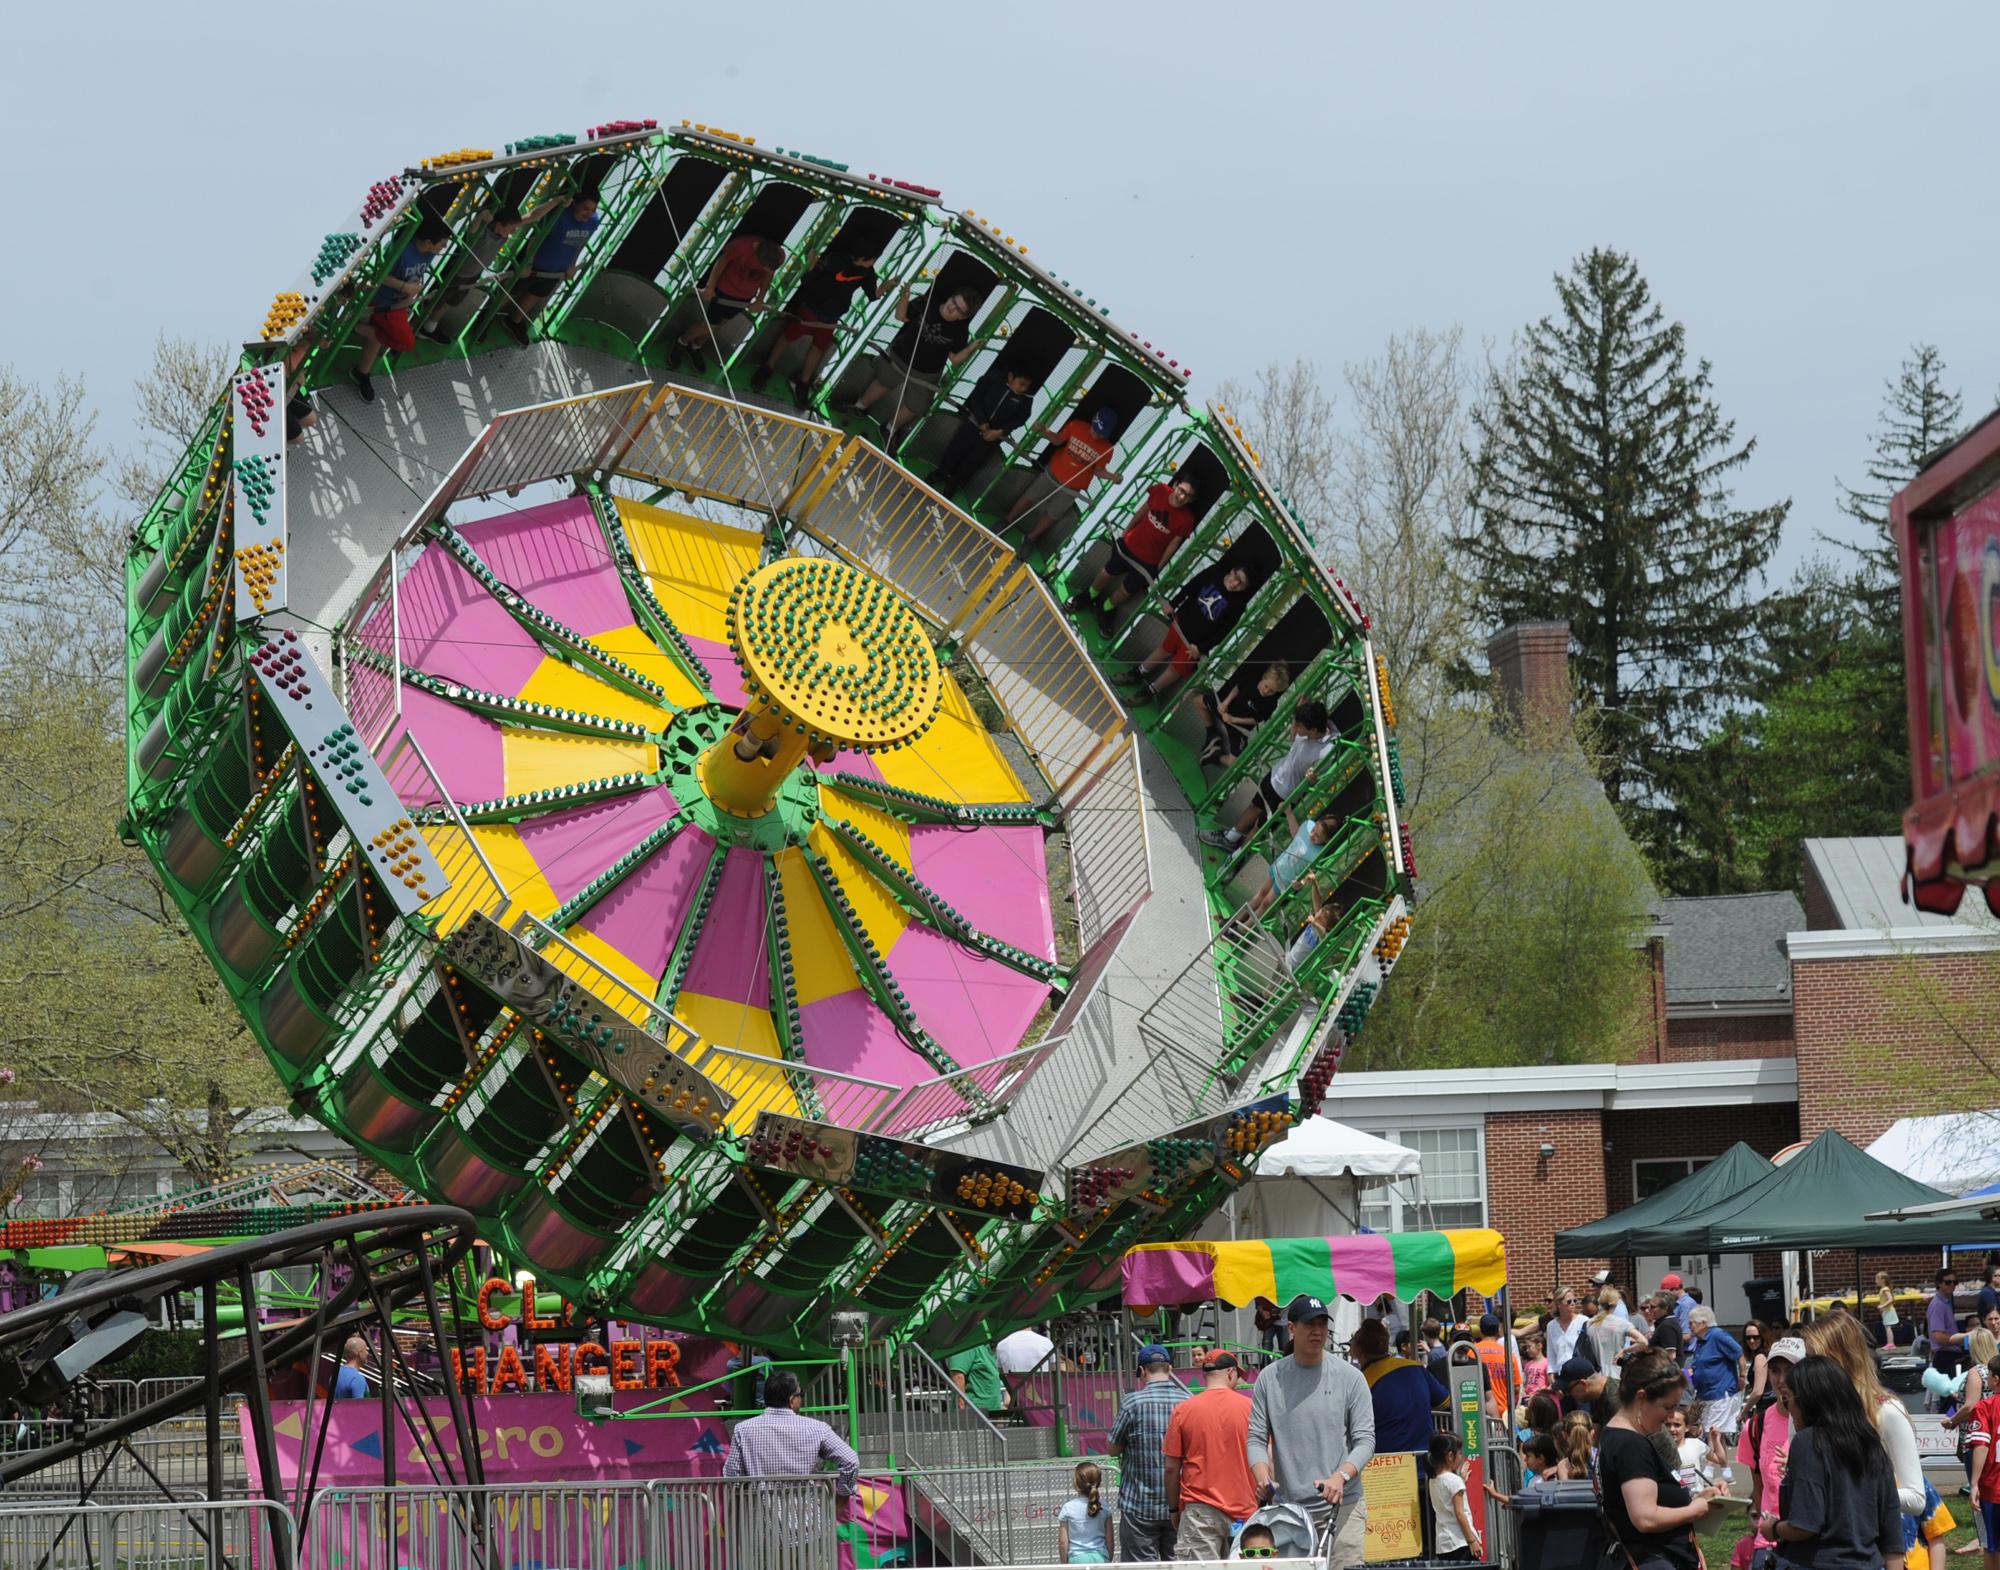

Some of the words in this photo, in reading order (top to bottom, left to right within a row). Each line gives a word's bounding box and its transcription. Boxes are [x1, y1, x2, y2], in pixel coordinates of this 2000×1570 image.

[1147, 509, 1171, 534] adidas
[1309, 1298, 1322, 1309] NY
[451, 1341, 681, 1395] HANGER
[403, 1416, 564, 1463] Zero
[1465, 1420, 1478, 1450] YES
[1366, 1455, 1404, 1468] SAFETY
